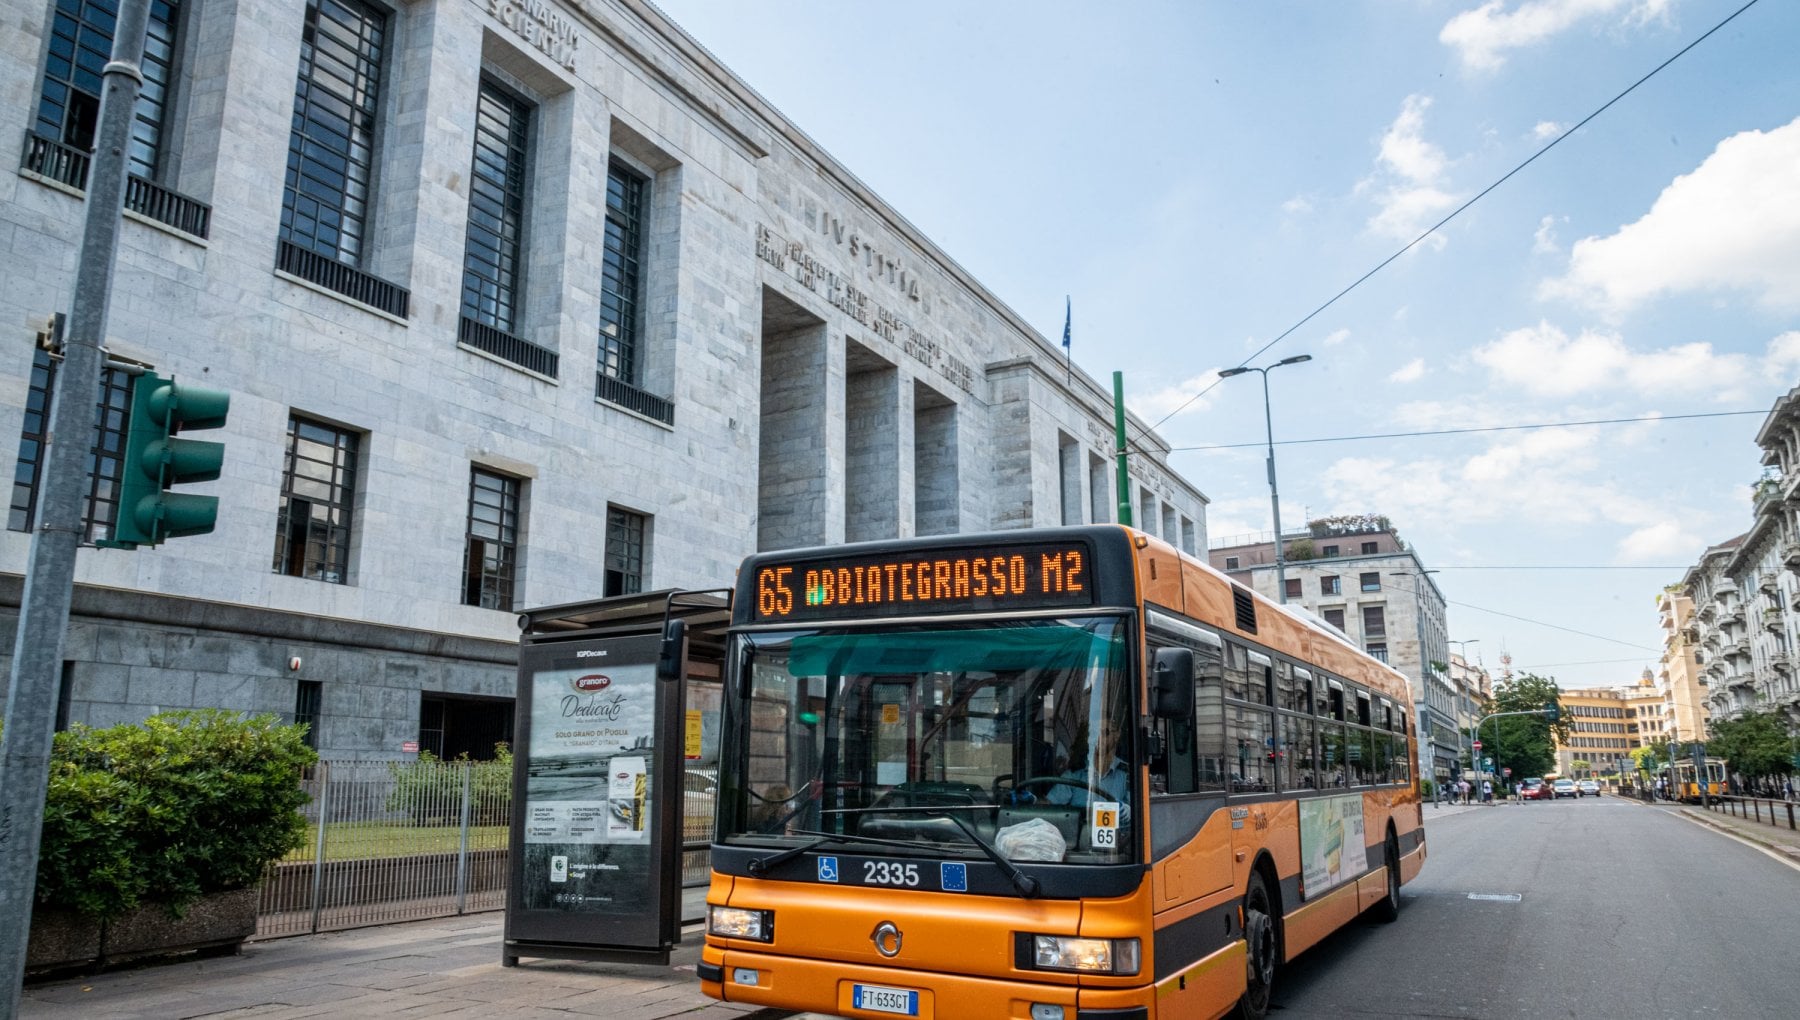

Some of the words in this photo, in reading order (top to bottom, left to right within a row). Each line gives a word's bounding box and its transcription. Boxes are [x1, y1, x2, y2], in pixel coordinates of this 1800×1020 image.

[510, 0, 579, 51] ANARVM
[823, 211, 920, 302] IVSTITIA
[759, 566, 793, 616] 65
[805, 555, 1026, 606] ABBIATEGRASSO
[1041, 551, 1083, 593] M2
[579, 678, 608, 688] granoro
[560, 694, 628, 722] Dedicato
[573, 730, 596, 738] GRANO
[1102, 811, 1110, 827] 6
[1097, 829, 1114, 844] 65
[863, 861, 919, 886] 2335
